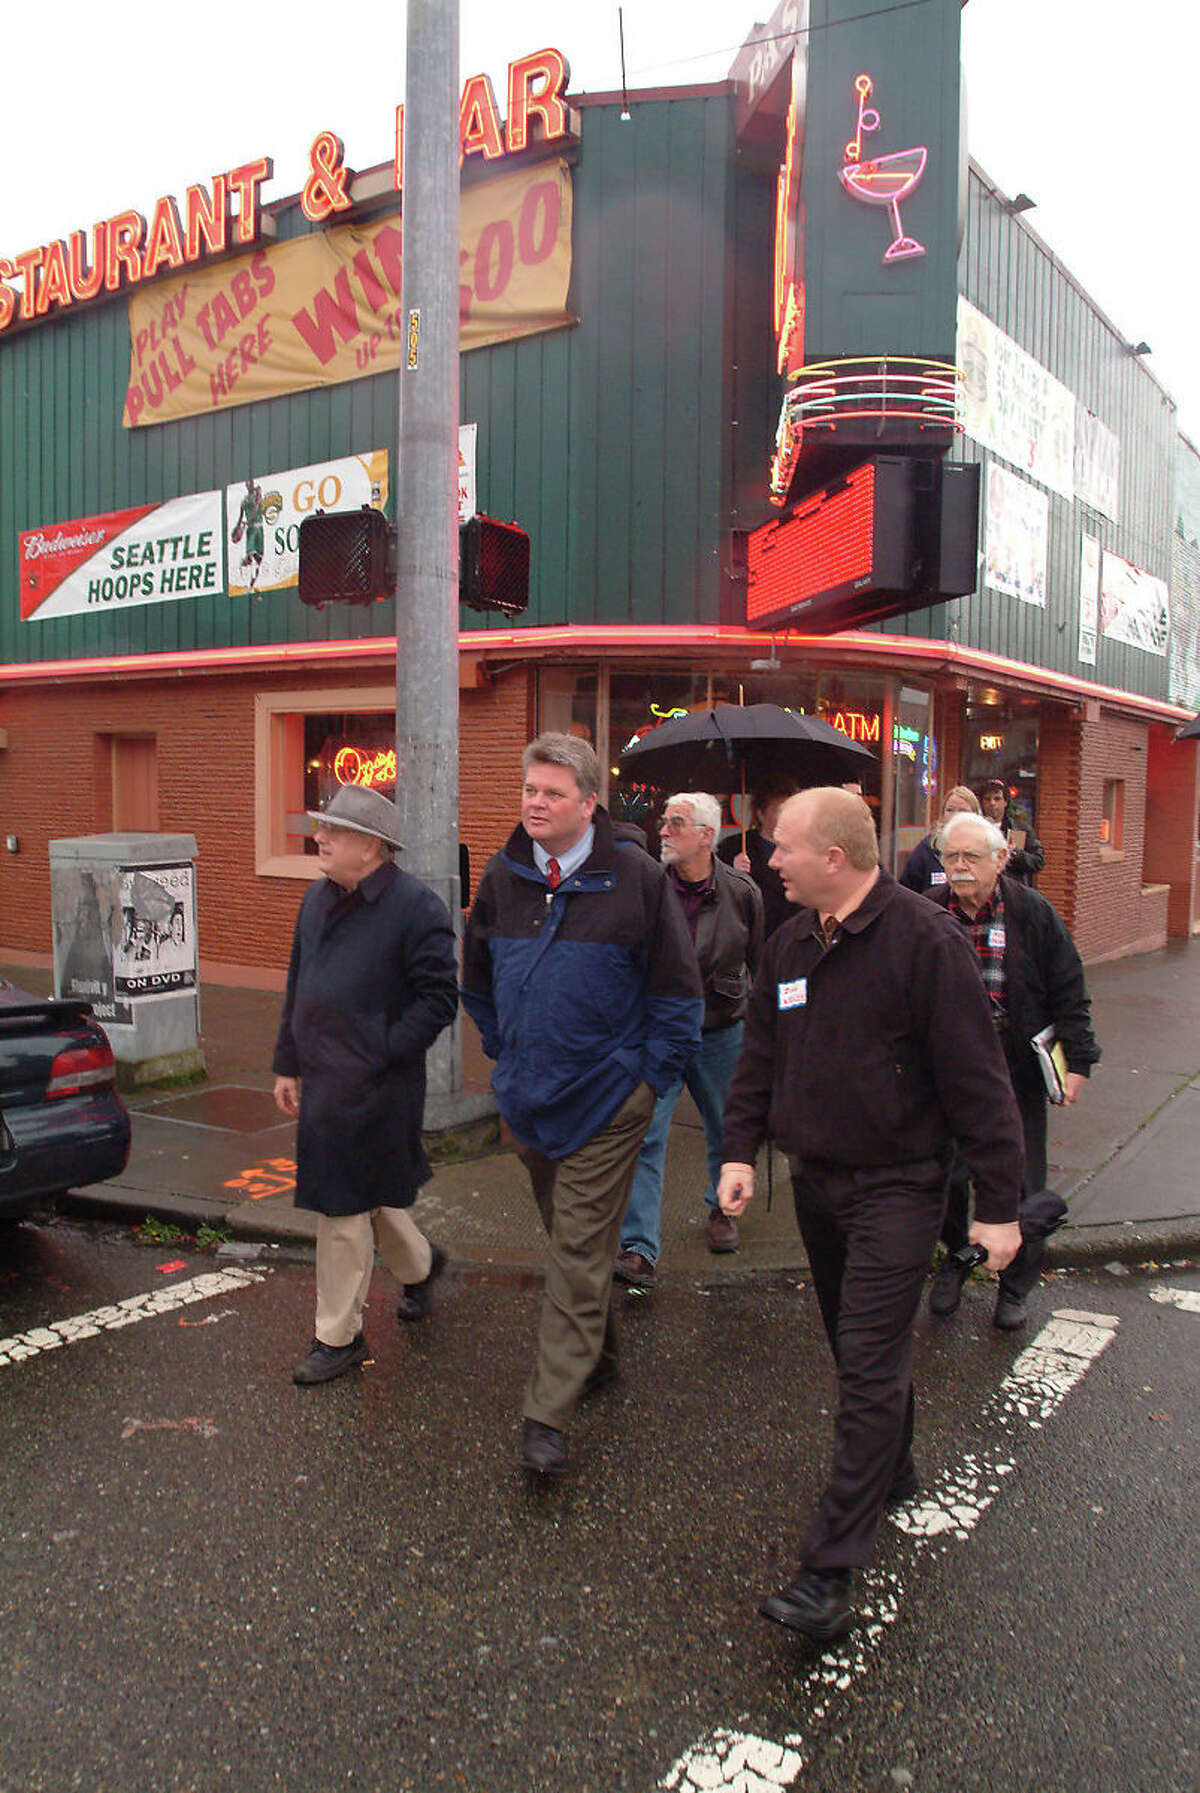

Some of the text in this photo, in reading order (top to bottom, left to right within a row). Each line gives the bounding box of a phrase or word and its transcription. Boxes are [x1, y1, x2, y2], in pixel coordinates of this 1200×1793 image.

[302, 131, 350, 222] &
[394, 48, 570, 191] AR
[126, 251, 276, 426] PULL TABS
[136, 282, 188, 368] PLAY
[209, 313, 273, 406] HERE
[355, 331, 383, 370] UP
[292, 475, 342, 512] GO
[23, 526, 106, 560] Budweiser
[110, 531, 213, 570] SEATTLE
[88, 562, 217, 604] HOOPS HERE
[833, 712, 879, 741] ATM
[126, 973, 181, 989] ON DVD
